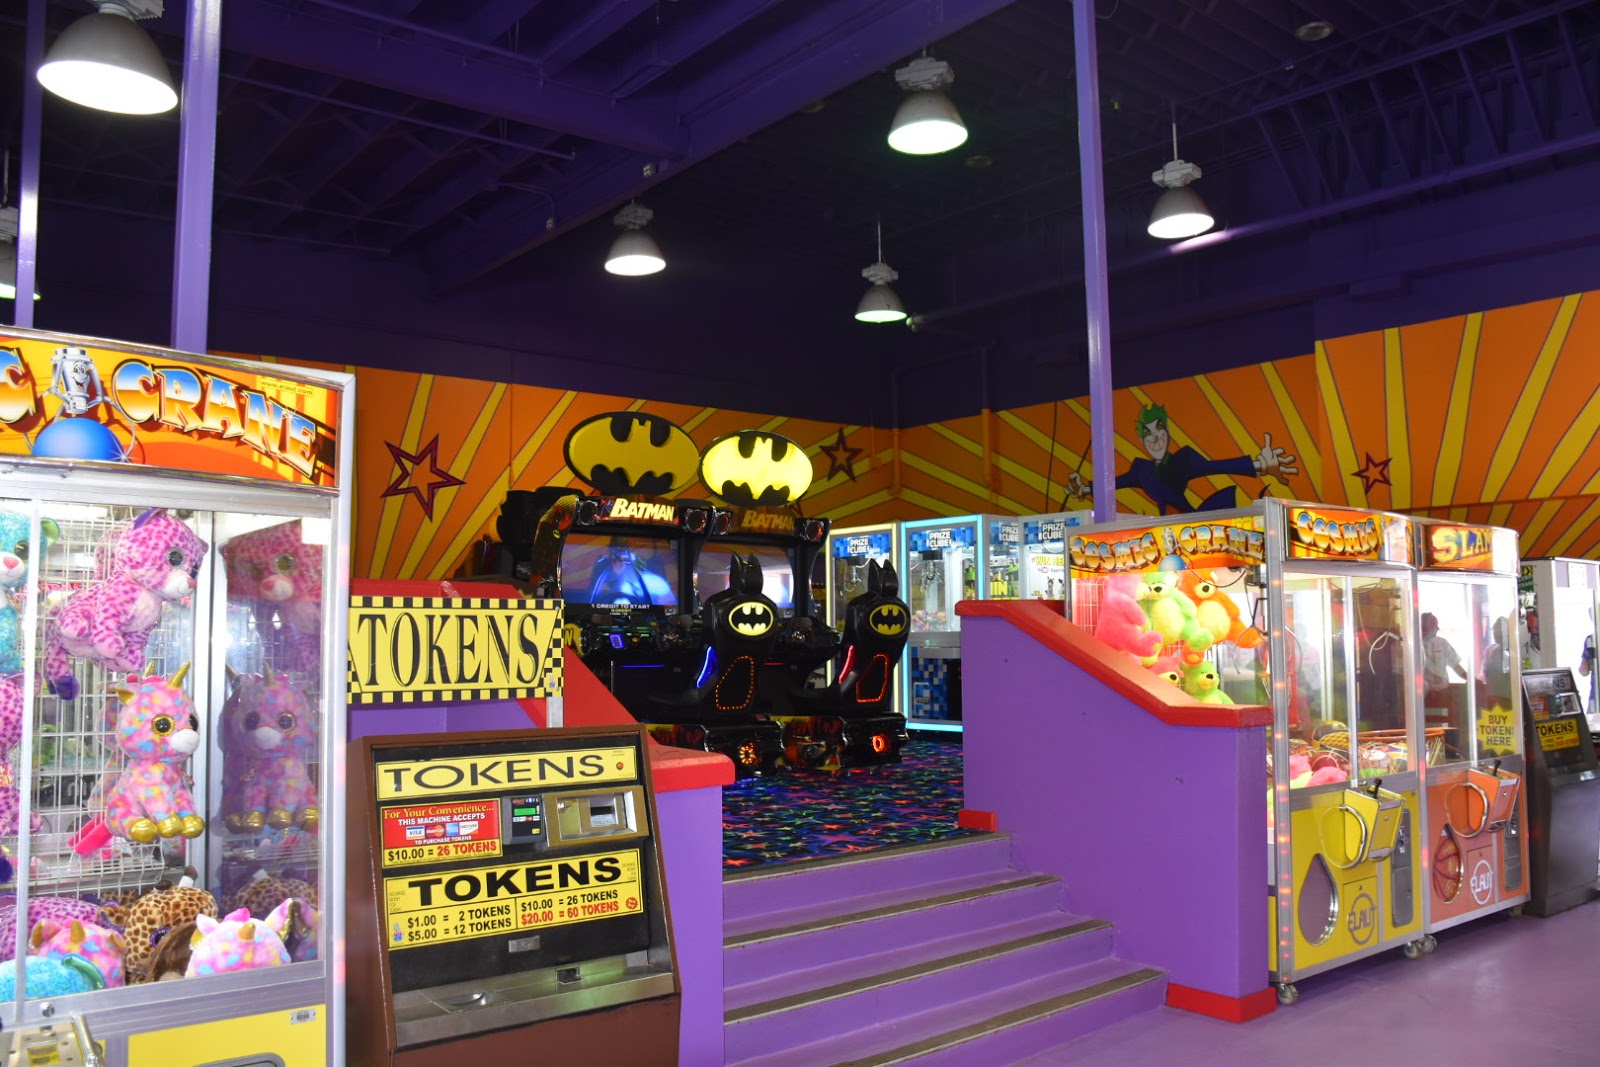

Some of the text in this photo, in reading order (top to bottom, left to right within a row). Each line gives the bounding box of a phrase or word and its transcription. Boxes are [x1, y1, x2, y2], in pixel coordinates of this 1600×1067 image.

[112, 358, 318, 479] CRANE
[609, 498, 675, 522] BATMAN
[741, 510, 795, 531] BATMAN
[850, 538, 869, 547] PRIZE
[929, 530, 951, 540] PRIZE
[1297, 511, 1378, 553] COSMIC
[1070, 524, 1264, 571] COSMIC CRANE
[357, 611, 540, 688] TOKENS
[1488, 714, 1508, 725] BUY
[1486, 735, 1512, 746] HERE
[384, 754, 605, 793] TOKENS
[384, 809, 401, 820] For
[404, 808, 427, 818] Your
[398, 812, 485, 826] THIS MACHINE ACCEPTS
[388, 848, 424, 862] $10.00
[437, 845, 450, 857] 26
[453, 841, 497, 855] TOKENS
[423, 837, 450, 845] PURCHASE
[408, 857, 622, 907] TOKENS
[1469, 870, 1493, 893] ELAUT
[521, 898, 553, 912] $10.00
[567, 895, 578, 905] 26
[581, 889, 618, 904] TOKENS
[408, 914, 437, 929] $1.00
[459, 911, 465, 922] 2
[468, 904, 511, 921] TOKENS
[521, 910, 554, 926] $20.00
[567, 907, 579, 919] 60
[581, 900, 619, 916] TOKENS
[1347, 905, 1376, 931] ELAUT
[408, 928, 437, 942] $5.00
[453, 924, 466, 935] 12
[469, 917, 512, 933] TOKENS
